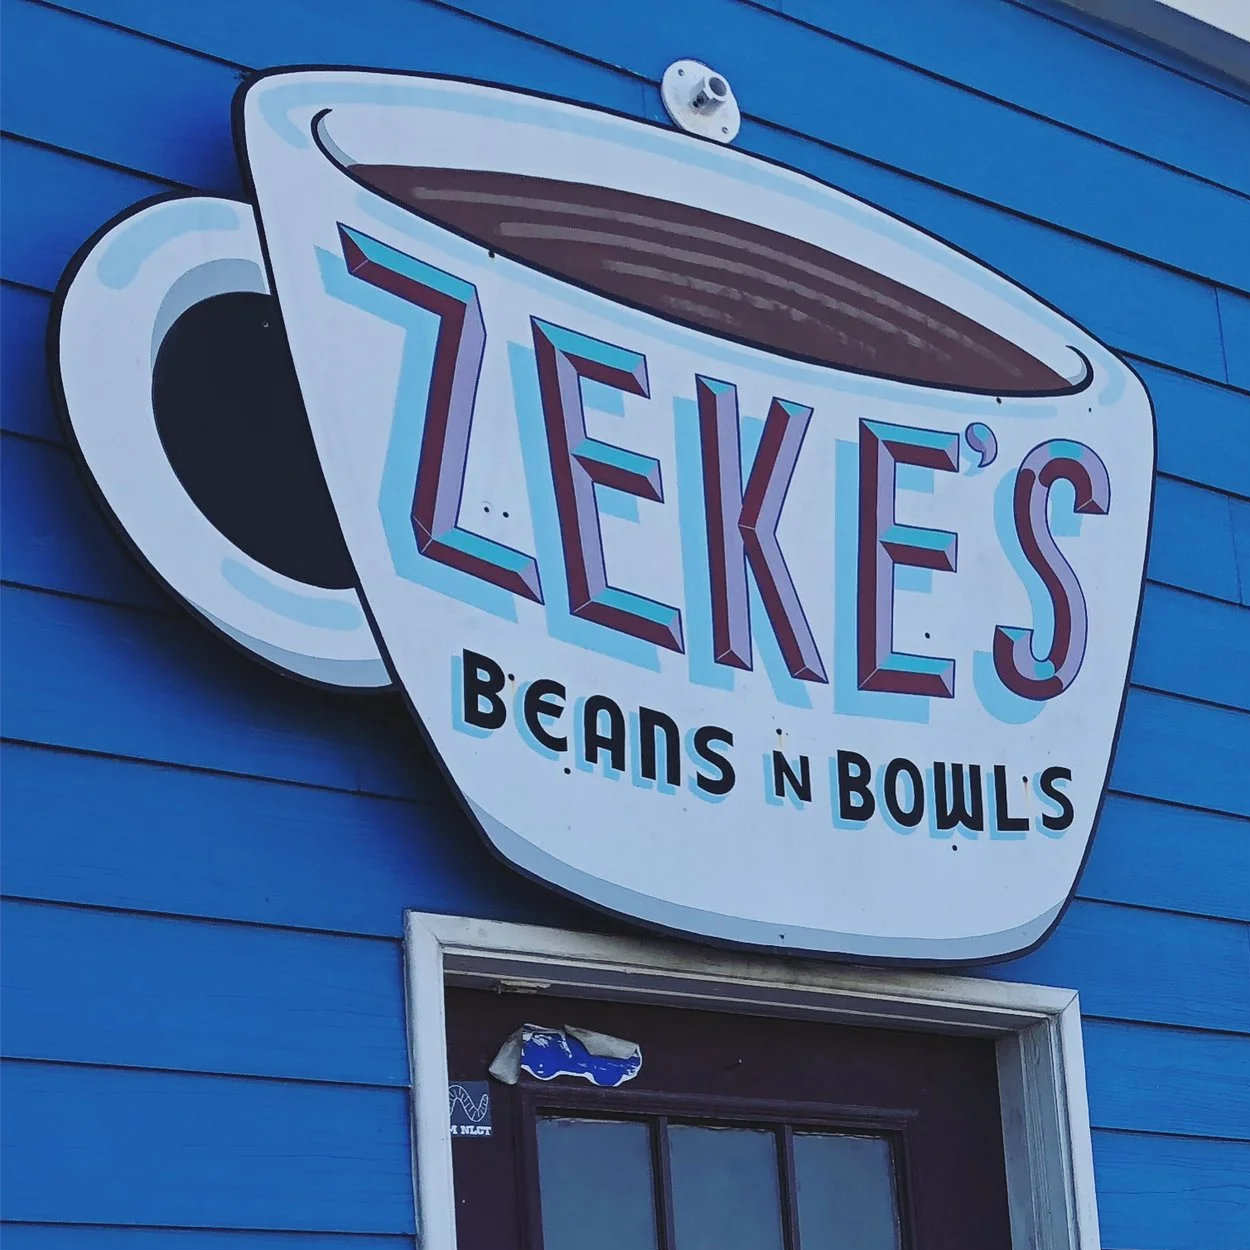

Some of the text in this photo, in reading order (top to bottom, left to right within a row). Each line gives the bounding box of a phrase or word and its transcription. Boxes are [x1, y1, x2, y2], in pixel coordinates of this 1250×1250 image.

[336, 222, 1111, 702] ZEKE'S
[462, 648, 736, 796] BEANS
[836, 748, 1075, 832] BOWLS
